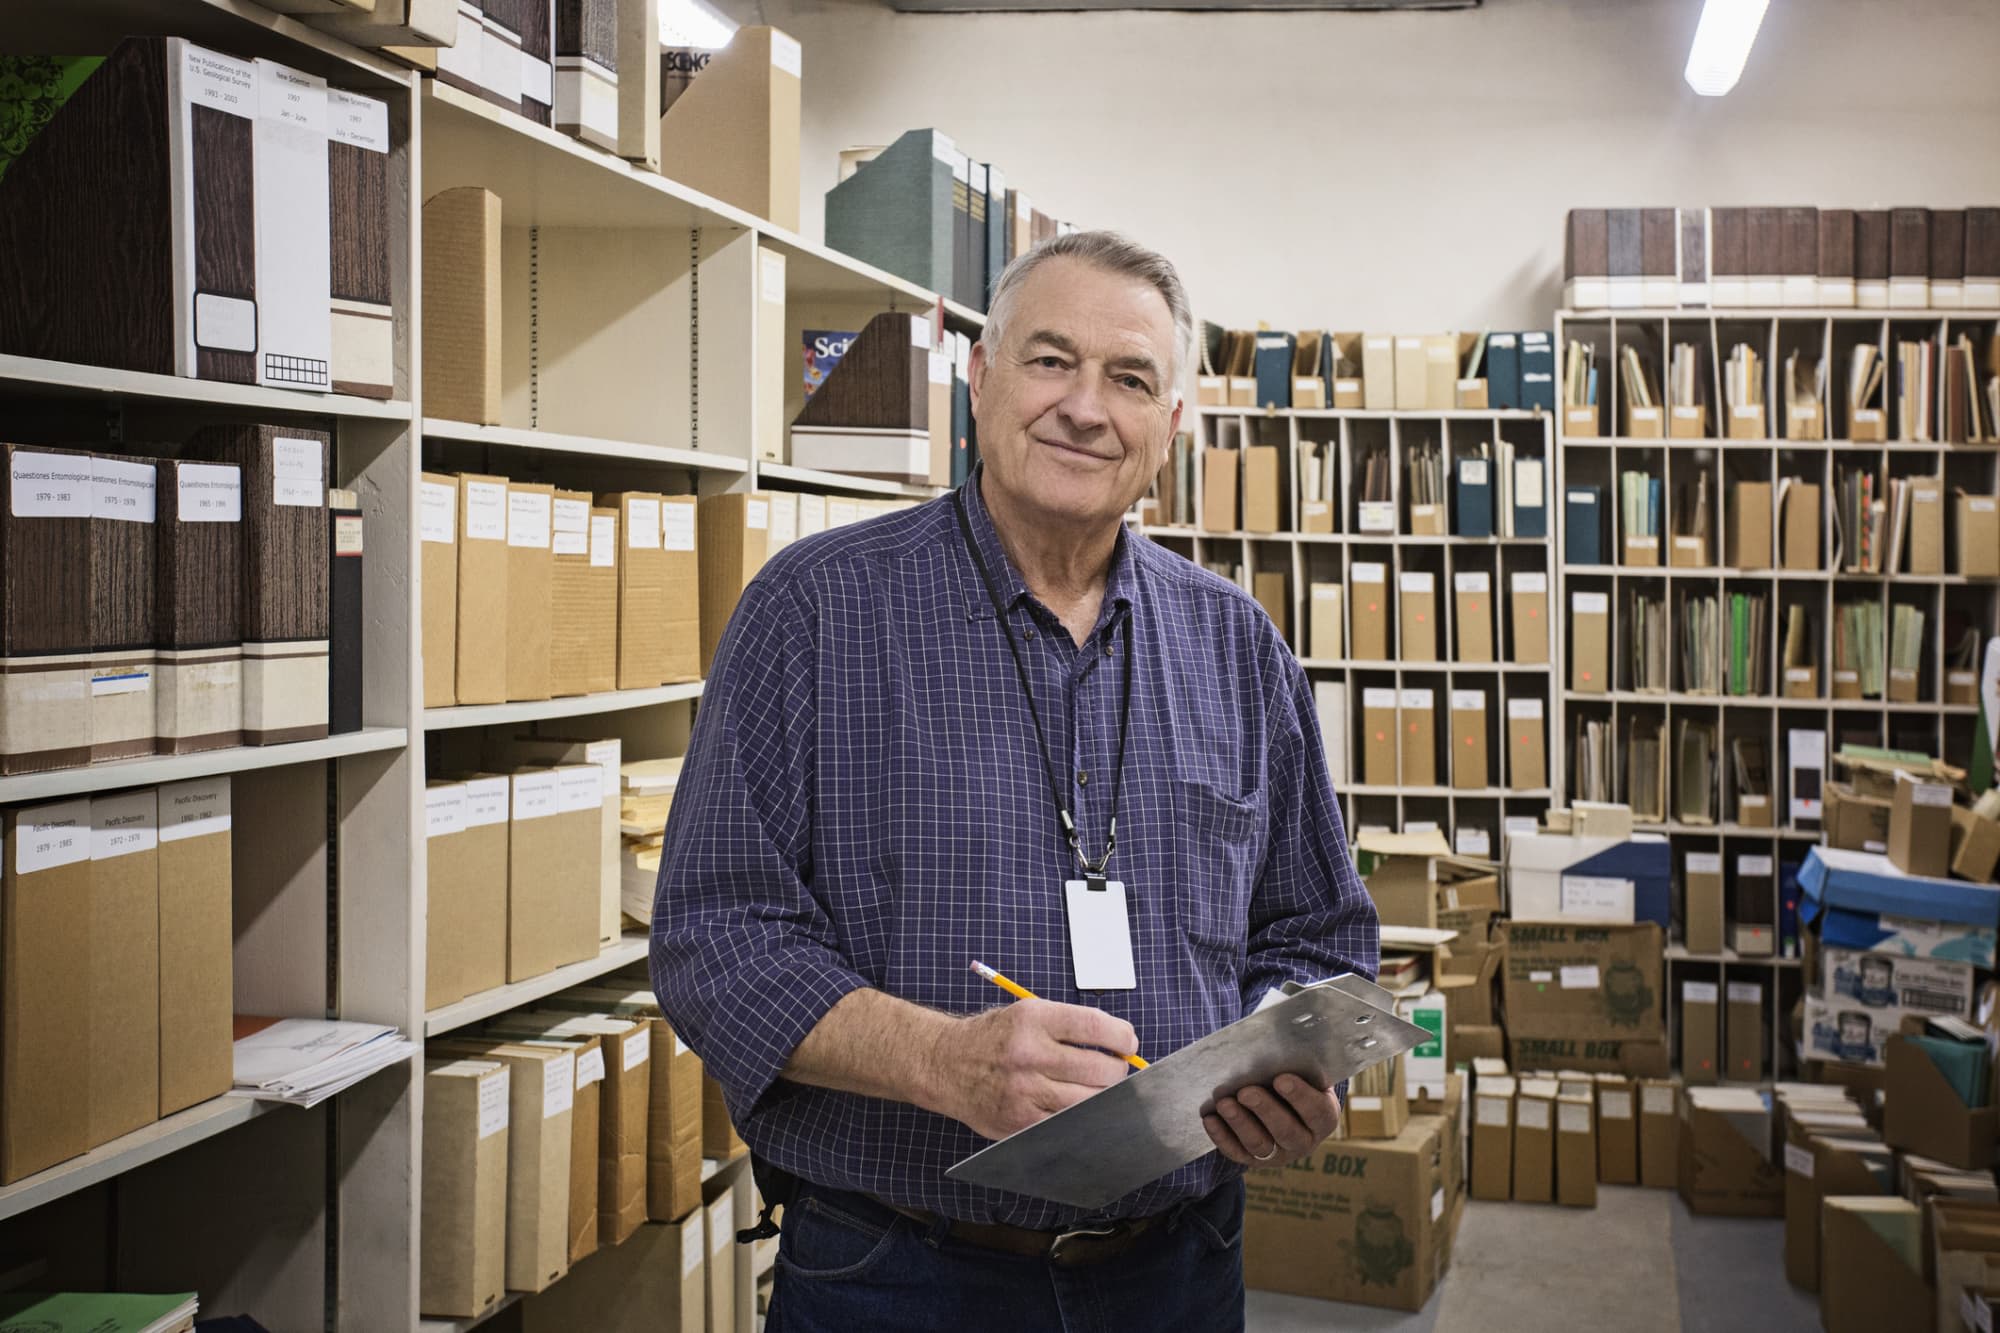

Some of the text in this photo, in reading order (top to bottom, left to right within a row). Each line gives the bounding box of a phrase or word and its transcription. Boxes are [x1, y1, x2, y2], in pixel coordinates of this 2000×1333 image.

[188, 53, 201, 64] New
[202, 57, 234, 75] Publications
[242, 71, 251, 79] the
[189, 63, 251, 89] U.S. Geological Survey
[276, 70, 310, 88] New Scientist
[337, 93, 349, 103] New
[814, 336, 858, 358] Sci
[12, 470, 50, 481] Quaestiones
[92, 474, 118, 485] aestiones
[174, 792, 217, 805] Pacific Discovery
[32, 818, 76, 833] Pacific Discovery
[104, 814, 145, 827] Pacific Discovery
[1511, 926, 1610, 943] SMALL BOX
[1519, 1038, 1622, 1061] SMALL BOX
[1322, 1152, 1368, 1178] BOX
